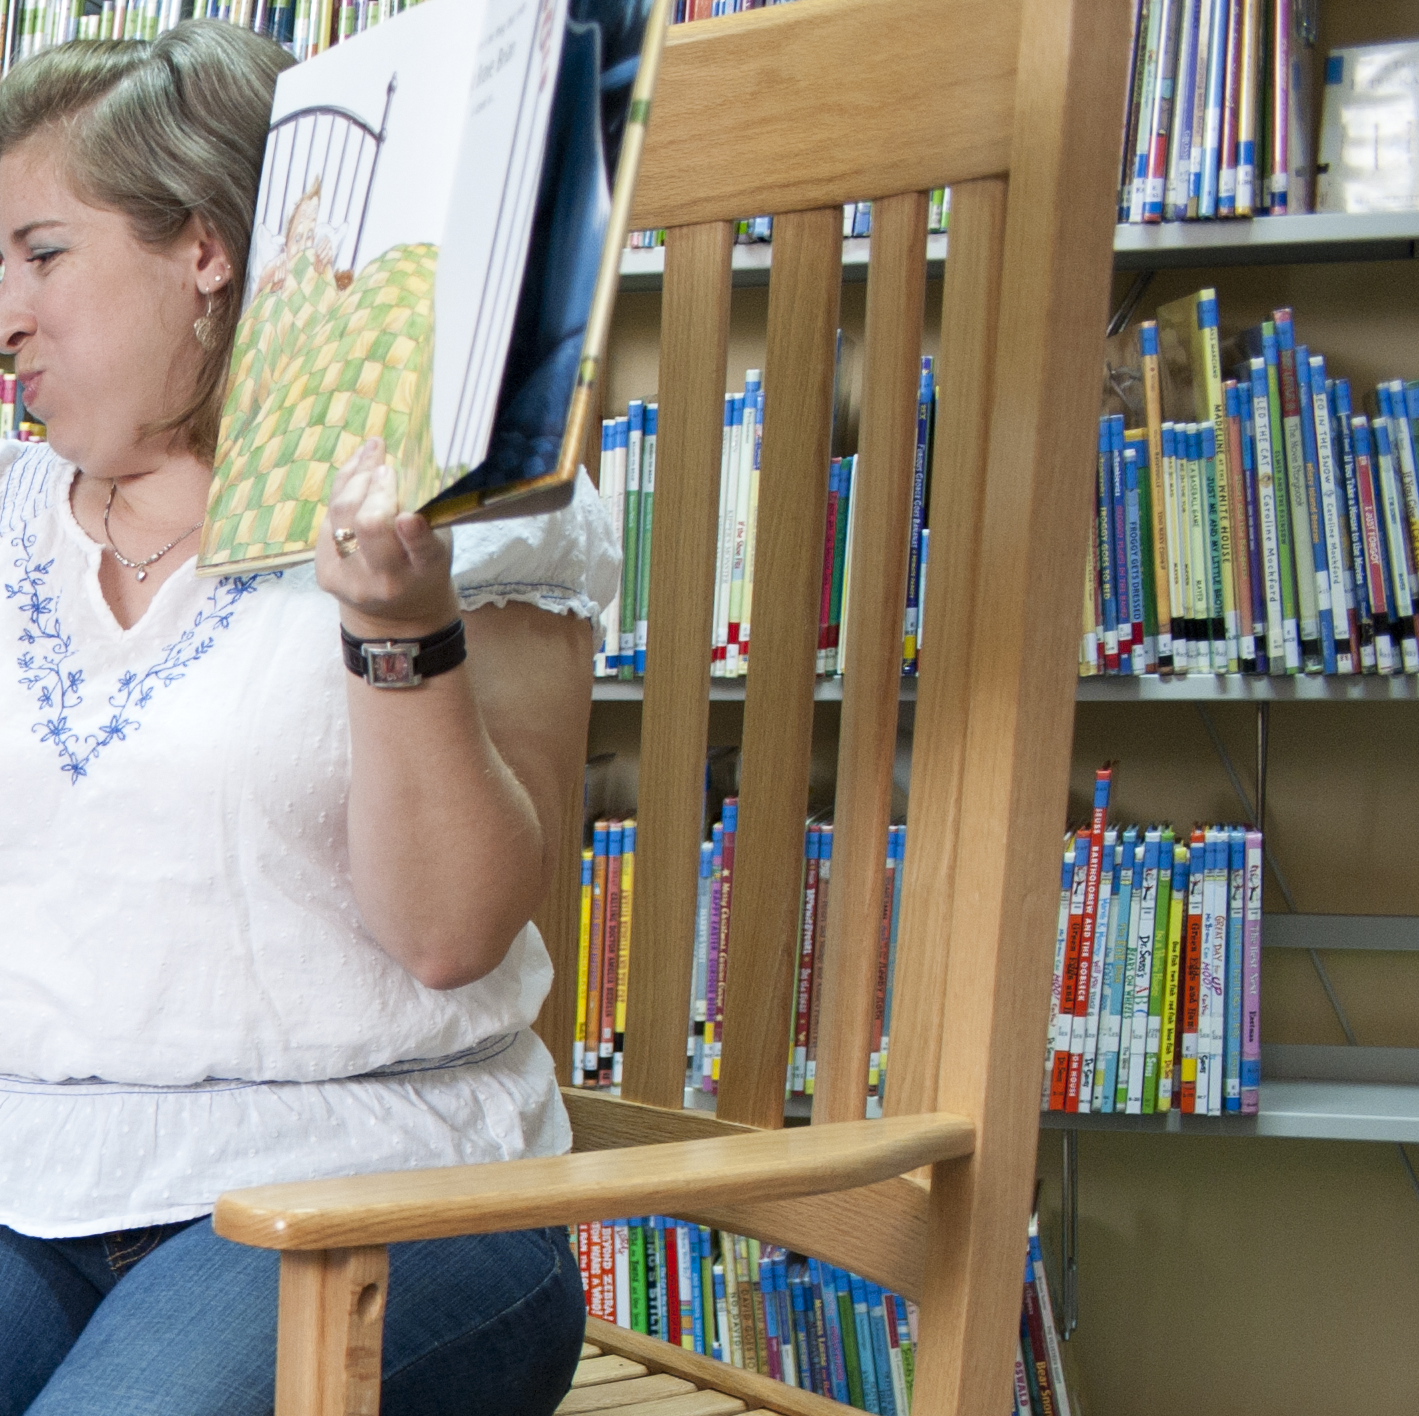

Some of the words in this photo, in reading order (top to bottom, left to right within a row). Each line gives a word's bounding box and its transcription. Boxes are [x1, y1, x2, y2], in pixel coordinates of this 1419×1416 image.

[1257, 396, 1267, 419] LEO
[1318, 415, 1326, 426] IN
[1214, 404, 1225, 457] MADELINE
[1259, 424, 1268, 442] THE
[1288, 424, 1298, 439] The
[1319, 432, 1328, 450] THE
[1260, 448, 1270, 466] CAT
[1322, 455, 1332, 484] SNOW
[1190, 474, 1198, 508] BASEBALL
[1207, 476, 1215, 499] JUST
[1291, 465, 1304, 507] Storybook
[1209, 502, 1217, 516] ME
[1219, 485, 1228, 522] WHITE
[1192, 510, 1200, 528] GAME
[1263, 495, 1274, 541] Caroline
[1326, 502, 1336, 538] Caroline
[1129, 522, 1138, 556] FROGGY
[1221, 527, 1230, 564] HOUSE
[1212, 556, 1220, 583] LITTLE
[1267, 548, 1278, 602] Mockford
[1330, 542, 1340, 584] Mockford
[1132, 581, 1141, 620] DRESSED
[1214, 589, 1223, 617] BROTH
[1085, 846, 1100, 914] BARTHOLOMEW
[1084, 918, 1094, 937] AND
[1190, 923, 1200, 952] Green
[1215, 916, 1226, 940] GREAT
[1081, 940, 1091, 957] THE
[1125, 947, 1138, 973] BEARS
[1213, 943, 1223, 962] DAY
[1078, 962, 1088, 1001] OOBLECK
[1126, 975, 1134, 987] ON
[1187, 957, 1199, 982] Eggs
[1211, 976, 1222, 996] UP
[1187, 1008, 1197, 1029] Ham
[602, 1228, 612, 1269] BEYOND
[603, 1274, 614, 1321] ZEBRA!
[1015, 1361, 1028, 1406] OSWALD
[1035, 1361, 1048, 1386] Bear
